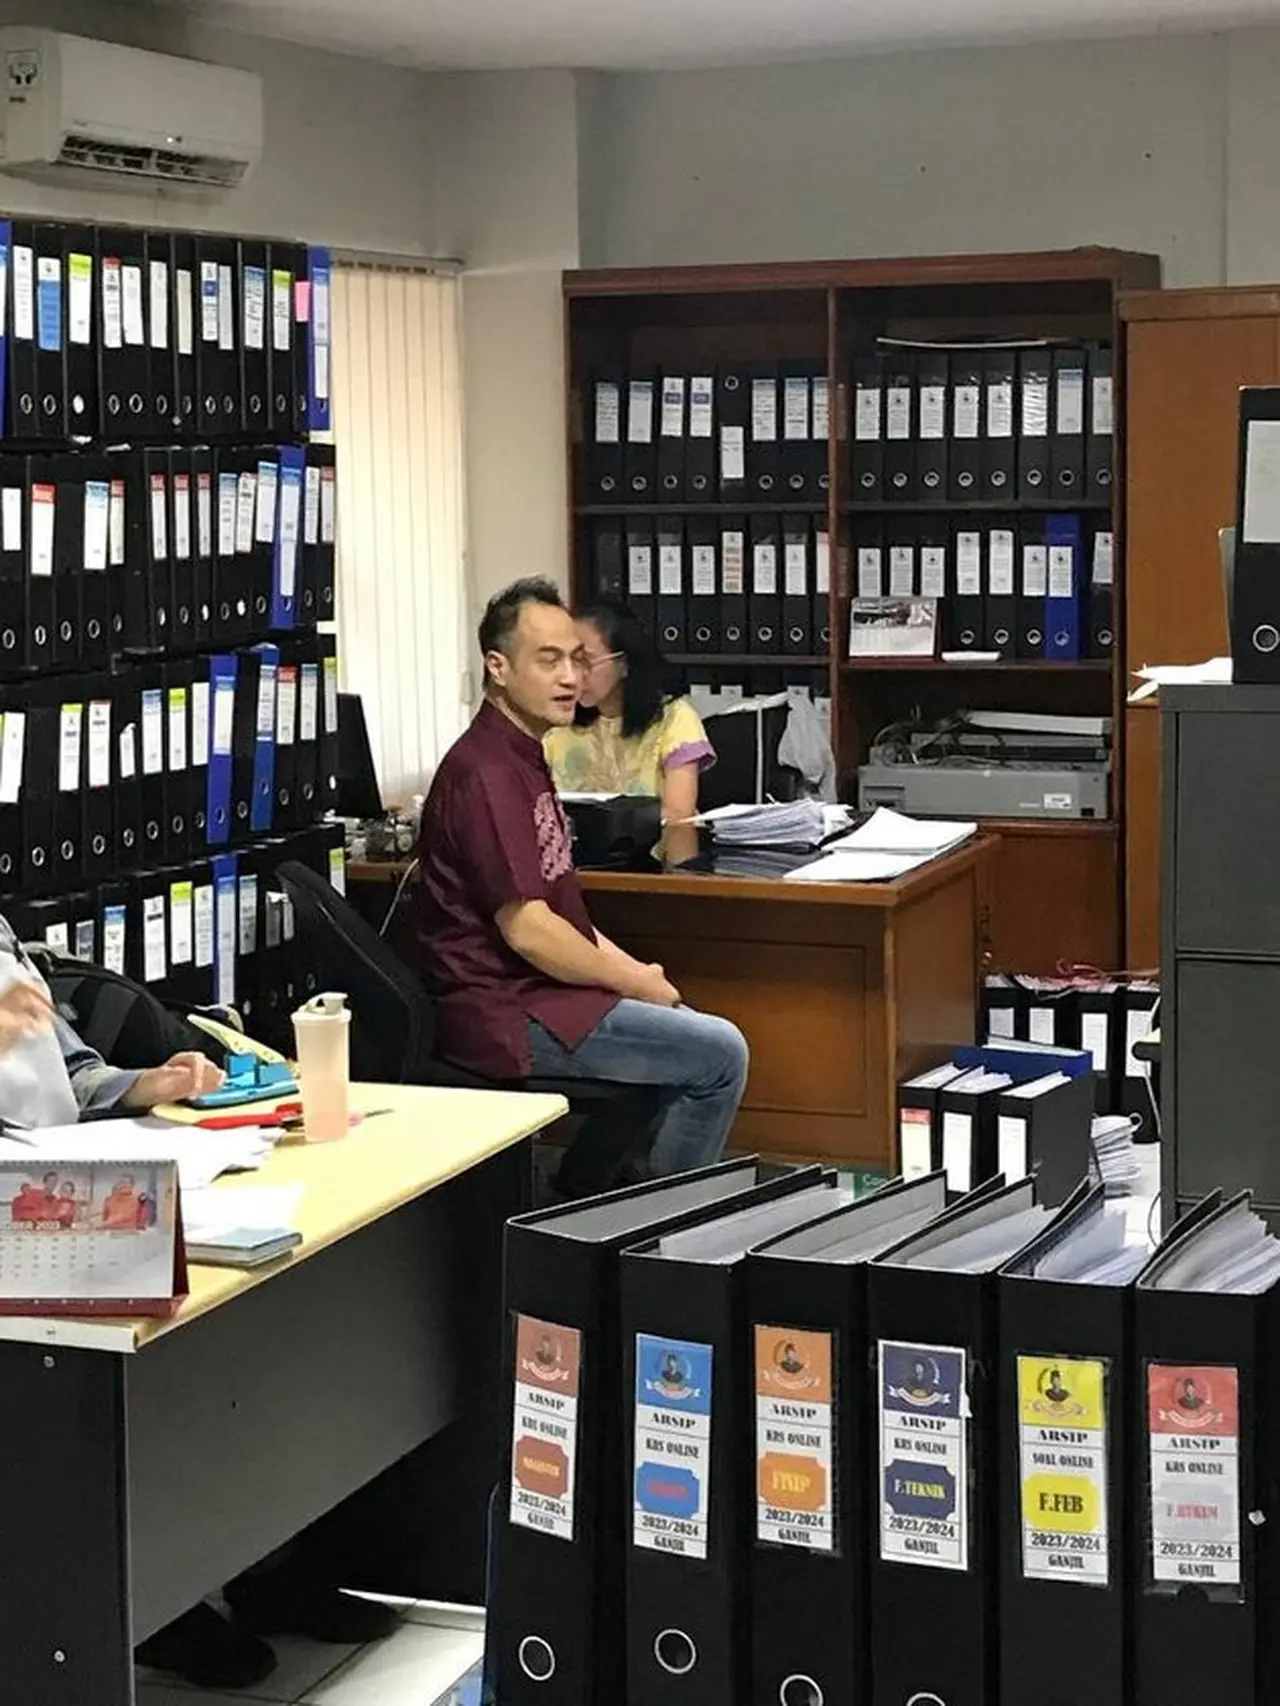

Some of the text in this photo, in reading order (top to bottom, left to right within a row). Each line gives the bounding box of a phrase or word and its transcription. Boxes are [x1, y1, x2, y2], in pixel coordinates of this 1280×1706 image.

[528, 1392, 565, 1411] ARSIP
[772, 1403, 817, 1419] ARSIP
[651, 1412, 696, 1429] ARSIP
[899, 1415, 946, 1431] ARSIP
[539, 1421, 567, 1439] ONLINE
[765, 1429, 822, 1448] KRS ONLINE
[1038, 1429, 1088, 1443] ARSIP
[645, 1437, 700, 1459] KRS ONLINE
[894, 1437, 947, 1455] KRS ONLINE
[1169, 1437, 1220, 1450] ARSIP
[1059, 1455, 1094, 1469] ONLINE
[1165, 1460, 1224, 1475] KRS ONLINE
[895, 1478, 946, 1499] F.TEKNIK
[517, 1491, 566, 1517] 2023/2024
[1038, 1492, 1084, 1514] F.FEB
[641, 1515, 699, 1536] 2023/2024
[765, 1509, 825, 1527] 2023/2024
[889, 1516, 954, 1537] 2023/2024
[778, 1528, 812, 1543] GANJIL
[1031, 1532, 1100, 1550] 2023/2024
[904, 1538, 939, 1554] GANJIL
[1160, 1542, 1232, 1558] 2023/2024
[1048, 1554, 1085, 1569] GANJIL
[1178, 1563, 1216, 1577] GANJIL
